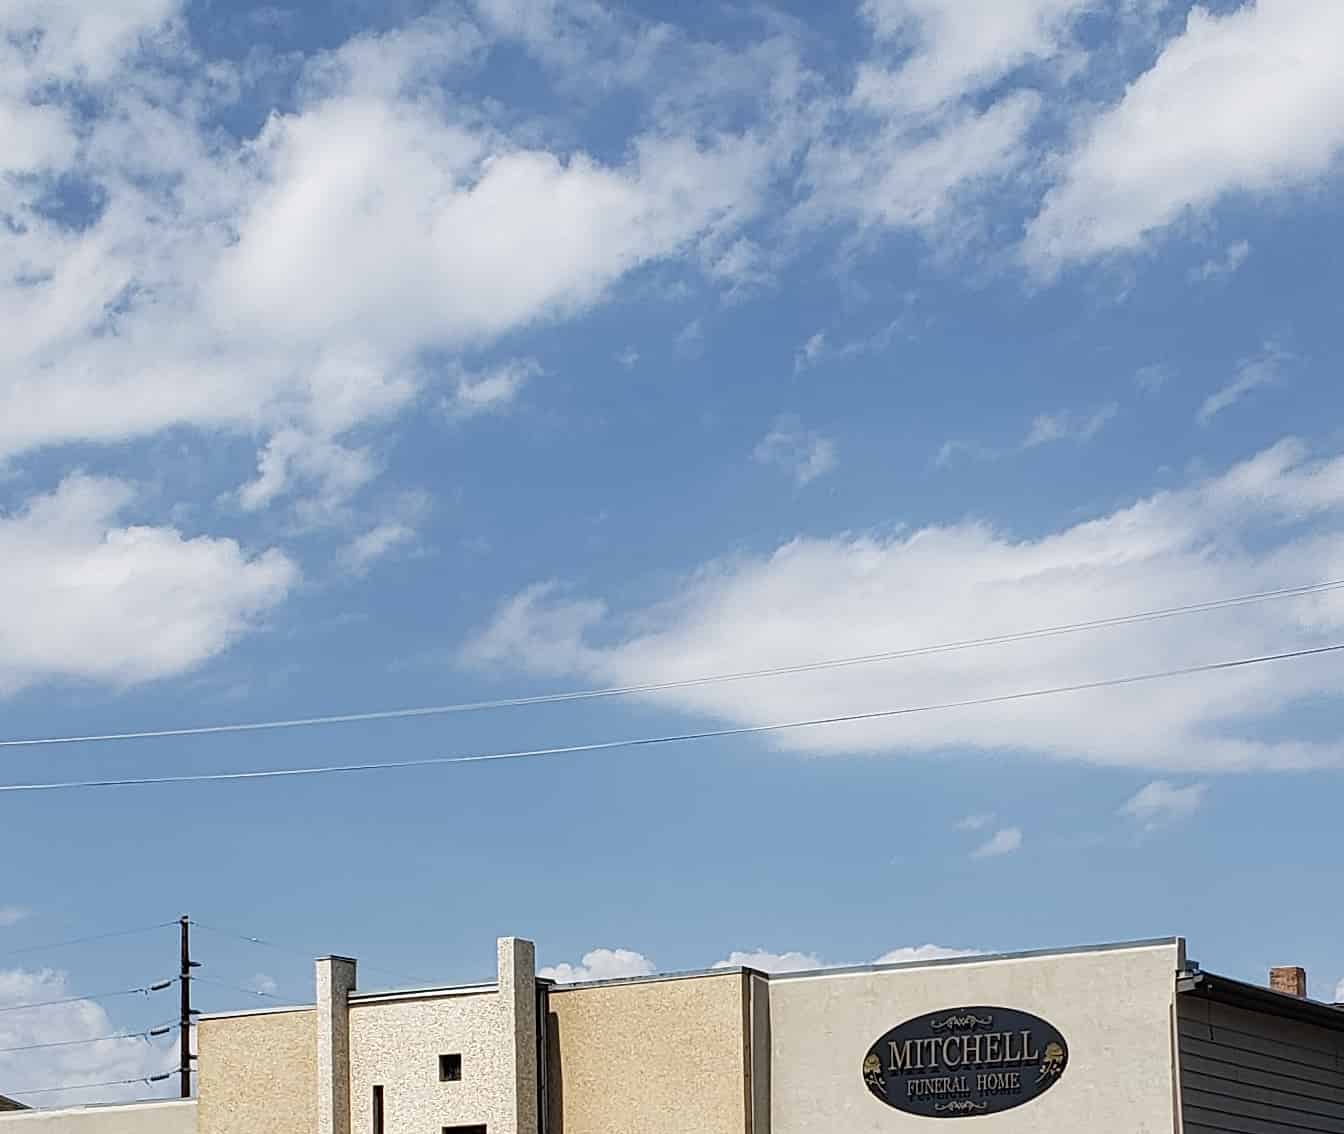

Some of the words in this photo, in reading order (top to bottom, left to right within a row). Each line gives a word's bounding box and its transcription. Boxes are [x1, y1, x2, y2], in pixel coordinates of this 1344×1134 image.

[888, 1031, 1038, 1071] MITCHELL
[907, 1076, 970, 1096] FUNERAL
[977, 1072, 1020, 1090] HOME
